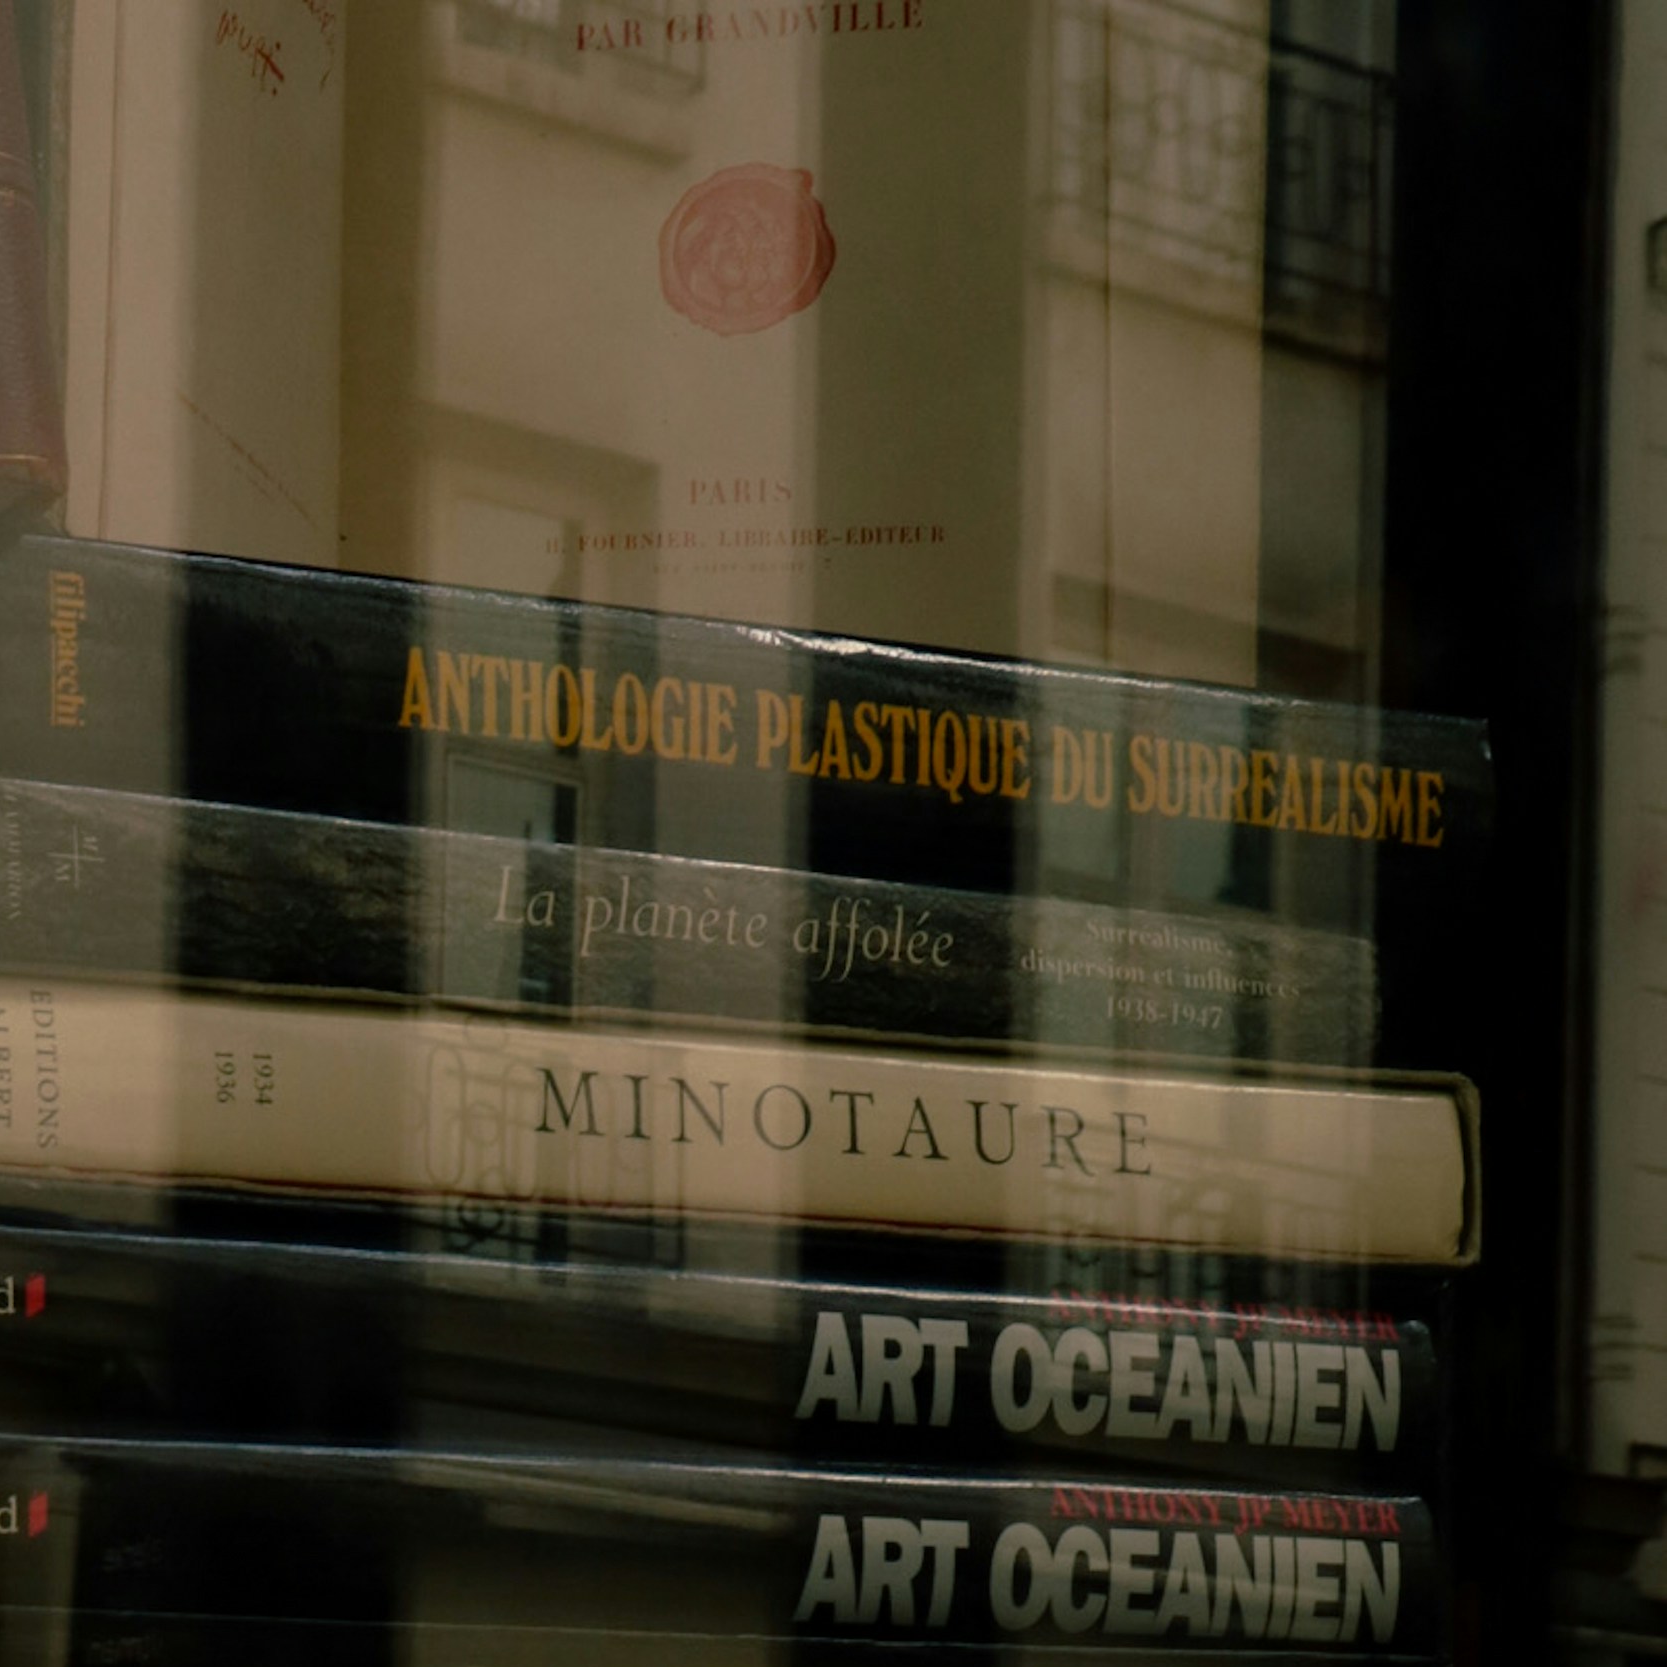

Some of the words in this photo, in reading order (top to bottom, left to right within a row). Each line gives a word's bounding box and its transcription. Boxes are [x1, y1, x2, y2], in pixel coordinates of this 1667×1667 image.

[574, 19, 643, 53] PAR
[664, 0, 925, 44] GRANDVILLE
[688, 478, 793, 505] PARIS
[48, 570, 87, 727] filipacchi
[398, 646, 735, 766] ANTHOLOGIE
[756, 691, 1031, 805] PLASTIQUE
[1052, 725, 1113, 808] DU
[494, 866, 557, 930] La
[581, 873, 768, 963] planète
[790, 895, 956, 985] affolée
[30, 990, 61, 1150] EDITIONS
[214, 1052, 236, 1103] 1936
[253, 1054, 274, 1104] 1934
[535, 1065, 1153, 1178] MINOTAURE
[795, 1311, 969, 1428] ART
[990, 1322, 1402, 1453] OCEANIEN
[1050, 1486, 1224, 1525] ANTHONY
[1234, 1496, 1272, 1535] JP
[1280, 1499, 1401, 1537] MEYER
[794, 1513, 970, 1629] ART
[990, 1522, 1402, 1646] OCEANIEN
